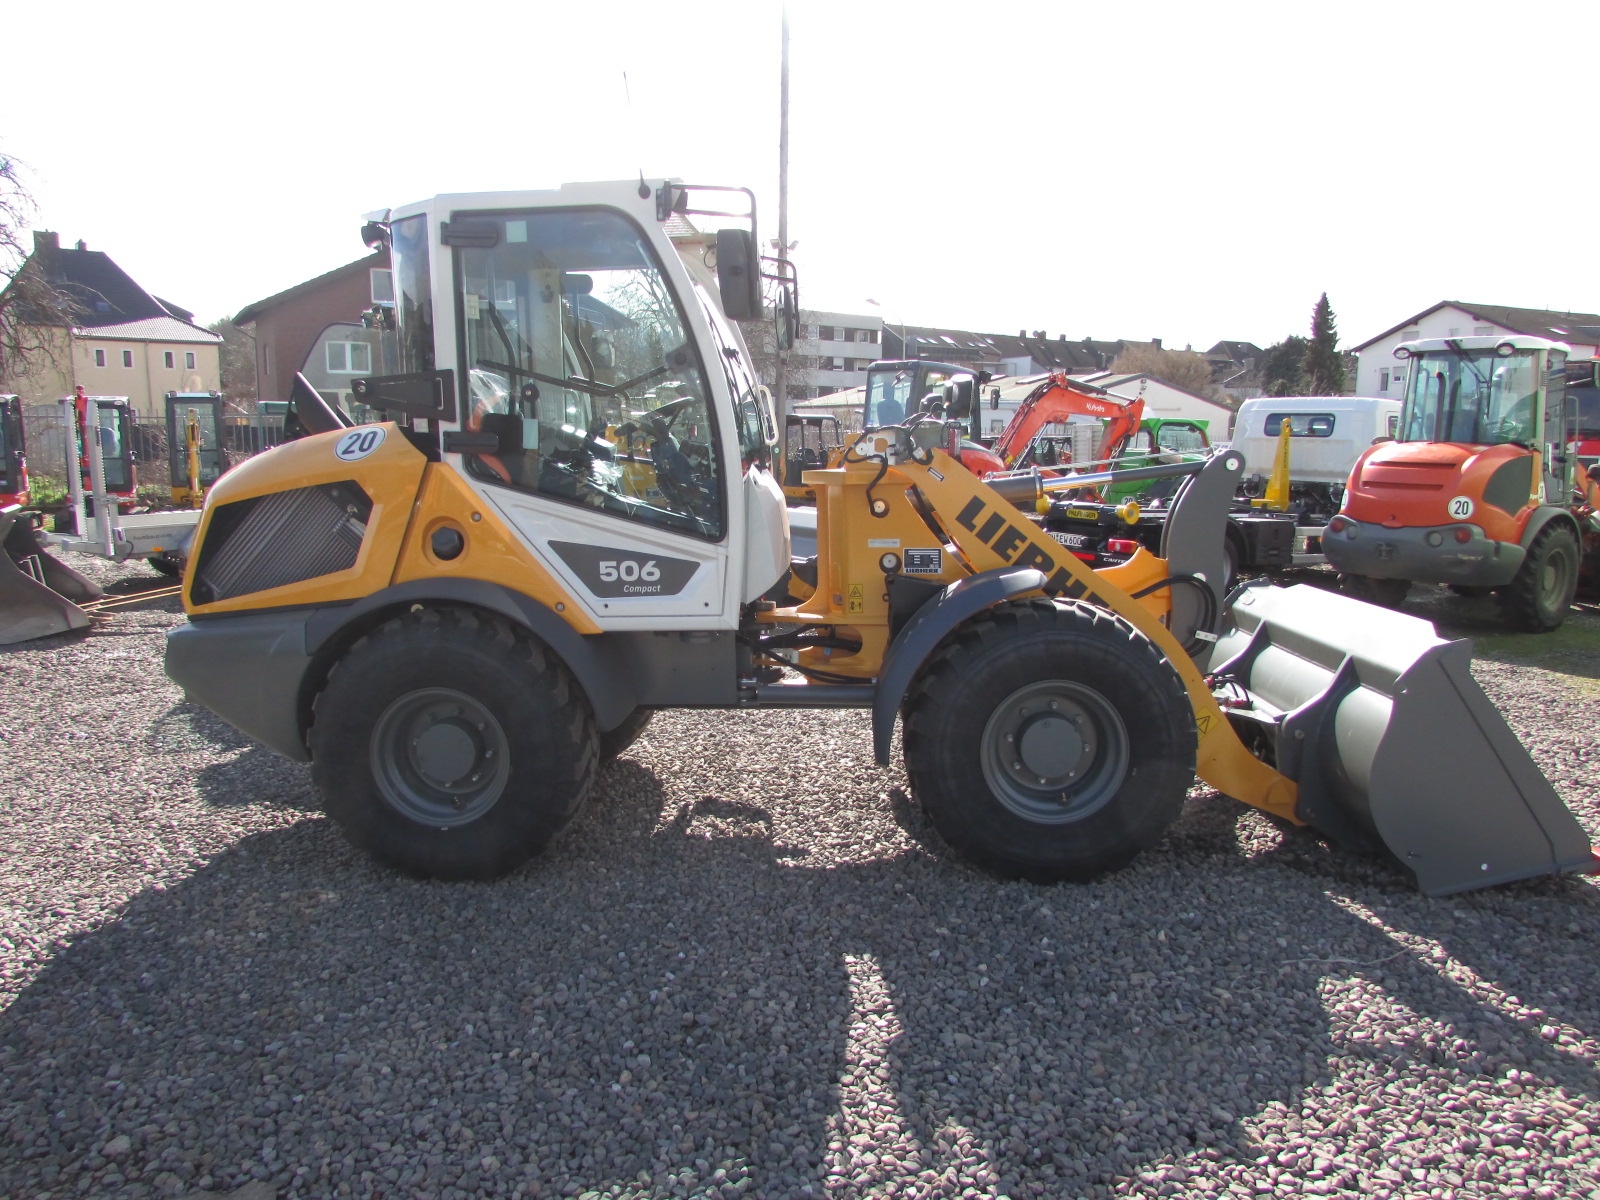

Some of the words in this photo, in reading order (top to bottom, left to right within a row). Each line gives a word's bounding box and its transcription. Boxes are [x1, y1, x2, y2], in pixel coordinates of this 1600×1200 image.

[1086, 403, 1105, 412] Kubota
[341, 430, 378, 455] 20
[1454, 501, 1469, 515] 20
[955, 495, 1118, 613] LIEBH
[599, 560, 661, 581] 506
[623, 584, 661, 593] Compact
